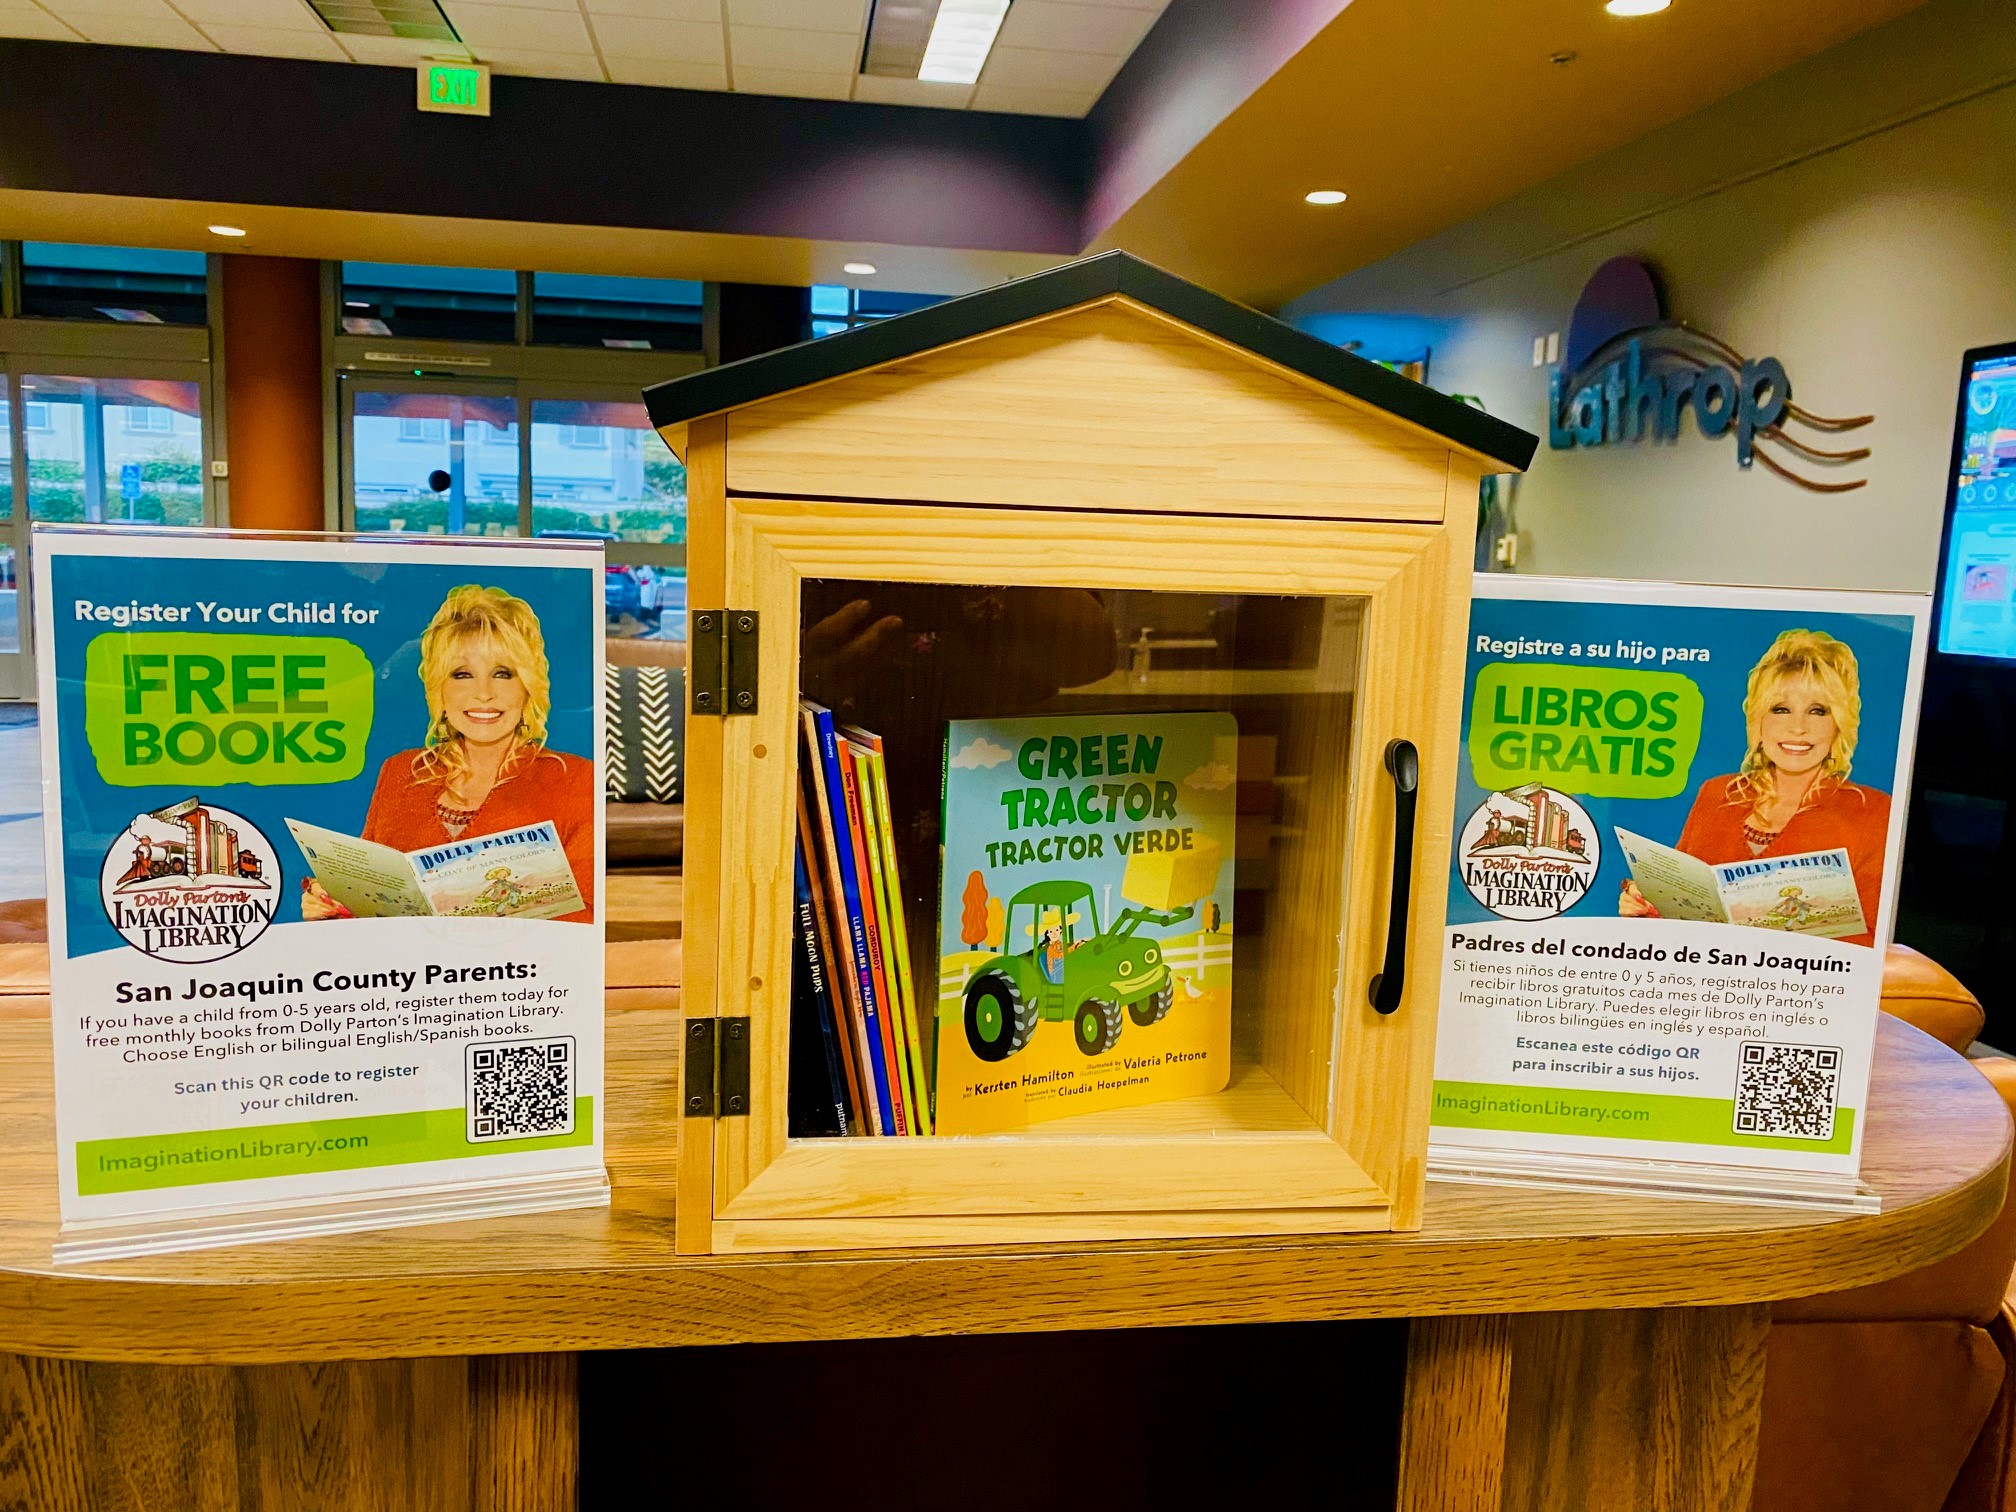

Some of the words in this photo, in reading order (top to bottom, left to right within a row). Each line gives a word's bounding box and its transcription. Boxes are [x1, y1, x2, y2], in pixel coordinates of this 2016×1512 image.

[430, 67, 479, 106] EXIT
[1549, 338, 1790, 470] Lathrop
[75, 600, 190, 627] Register
[196, 602, 261, 623] Your
[268, 602, 336, 624] Child
[341, 603, 379, 624] for
[1476, 635, 1564, 659] Registre
[1569, 643, 1582, 656] a
[1586, 644, 1611, 658] su
[1616, 640, 1656, 664] hijo
[1662, 648, 1710, 665] para
[123, 654, 328, 715] FREE
[1494, 685, 1680, 732] LIBROS
[123, 720, 347, 766] BOOKS
[1017, 734, 1163, 781] GREEN
[1489, 730, 1677, 778] GRATIS
[845, 772, 853, 790] Don
[849, 791, 857, 826] Freeman
[1000, 780, 1178, 830] TRACTOR
[419, 843, 474, 870] DOLLY
[482, 827, 550, 849] PARTON
[985, 833, 1104, 868] TRACTOR
[1113, 827, 1194, 856] VERDE
[437, 867, 464, 879] COAT
[479, 857, 508, 869] MANY
[509, 848, 546, 861] COLORS
[1466, 862, 1590, 893] IMAGINATION
[1482, 858, 1517, 873] Dolly
[1723, 863, 1771, 882] DOLLY
[1780, 854, 1842, 869] PARTON
[113, 898, 272, 929] IMAGINATION
[134, 890, 180, 907] Dolly
[183, 890, 251, 906] Parton's
[1486, 888, 1566, 912] LIBRARY
[143, 924, 247, 953] LIBRARY
[853, 916, 863, 942] LLAMA
[857, 943, 867, 969] LLAMA
[868, 925, 880, 971] CORDUROY
[1451, 933, 1525, 953] Padres
[1531, 938, 1565, 955] del
[1572, 942, 1667, 962] condado
[1673, 946, 1701, 963] de
[1707, 948, 1747, 966] San
[1754, 952, 1851, 975] Joaquín:
[116, 982, 172, 1003] San
[181, 973, 303, 1002] Joaquin
[312, 969, 416, 993] County
[425, 962, 537, 984] Parents:
[1453, 960, 1466, 972] Si
[1470, 961, 1512, 975] tienes
[1516, 964, 1553, 977] niños
[1558, 966, 1576, 979] de
[1581, 969, 1617, 981] entre
[1622, 970, 1631, 981] 0
[1634, 973, 1643, 985] y
[1646, 971, 1655, 983] 5
[1659, 974, 1696, 987] años,
[1701, 976, 1777, 991] regístralos
[1781, 979, 1808, 996] hoy
[1812, 984, 1845, 997] para
[1470, 978, 1516, 990] recibir
[1520, 979, 1559, 993] libros
[1563, 984, 1625, 998] gratuitos
[1629, 987, 1663, 999] cada
[1668, 992, 1697, 1002] mes
[1701, 991, 1720, 1003] de
[1725, 992, 1762, 1008] Dolly
[80, 1017, 91, 1030] If
[96, 1018, 127, 1033] you
[133, 1014, 174, 1027] have
[179, 1015, 188, 1024] a
[194, 1008, 233, 1023] child
[239, 1007, 277, 1020] from
[283, 1003, 308, 1017] 0-5
[314, 1003, 356, 1018] years
[361, 998, 390, 1012] old,
[395, 996, 454, 1011] register
[458, 992, 497, 1005] them
[502, 988, 544, 1003] today
[548, 986, 569, 999] for
[863, 987, 874, 1017] PAJAMA
[1459, 992, 1542, 1008] Imagination
[1547, 998, 1598, 1014] Library.
[1603, 1000, 1655, 1015] Puedes
[1660, 1004, 1701, 1018] elegir
[1705, 1006, 1745, 1021] libros
[1749, 1013, 1767, 1022] en
[1771, 1011, 1815, 1026] inglés
[1819, 1017, 1829, 1026] o
[86, 1034, 120, 1047] free
[126, 1028, 195, 1045] monthly
[201, 1025, 251, 1040] books
[257, 1023, 295, 1036] from
[300, 1017, 341, 1034] Dolly
[414, 1008, 504, 1025] Imagination
[509, 1004, 564, 1019] Library.
[1516, 1011, 1556, 1025] libros
[1560, 1014, 1624, 1030] bilingües
[1628, 1021, 1646, 1030] en
[1650, 1020, 1693, 1034] inglés
[1697, 1025, 1705, 1036] y
[1709, 1024, 1769, 1038] español.
[123, 1049, 188, 1063] Choose
[194, 1041, 254, 1059] English
[260, 1043, 277, 1053] or
[282, 1034, 351, 1051] bilingual
[356, 1025, 479, 1048] English/Spanish
[484, 1022, 533, 1037] books.
[1516, 1037, 1578, 1052] Escanea
[1582, 1043, 1613, 1054] este
[1618, 1043, 1671, 1060] código
[1676, 1046, 1700, 1060] QR
[1124, 1057, 1161, 1070] Valeria
[1165, 1051, 1208, 1065] Petrone
[1512, 1058, 1546, 1073] para
[1551, 1059, 1613, 1075] inscribir
[1617, 1066, 1625, 1076] a
[1629, 1067, 1654, 1078] sus
[1658, 1066, 1699, 1083] hijos.
[174, 1080, 217, 1095] Scan
[221, 1076, 254, 1091] this
[259, 1074, 283, 1089] QR
[288, 1070, 330, 1086] code
[334, 1071, 351, 1082] to
[356, 1064, 419, 1081] register
[974, 1079, 1017, 1096] Kersten
[1022, 1069, 1074, 1087] Hamilton
[1058, 1085, 1092, 1097] Claudia
[1097, 1076, 1150, 1091] Hoepelman
[240, 1097, 280, 1114] your
[284, 1091, 359, 1108] children.
[895, 1102, 905, 1132] PUFFIN
[1436, 1093, 1650, 1122] ImaginationLibrary.com
[835, 1102, 847, 1137] putnam
[99, 1134, 369, 1173] ImaginationLibrary.com
